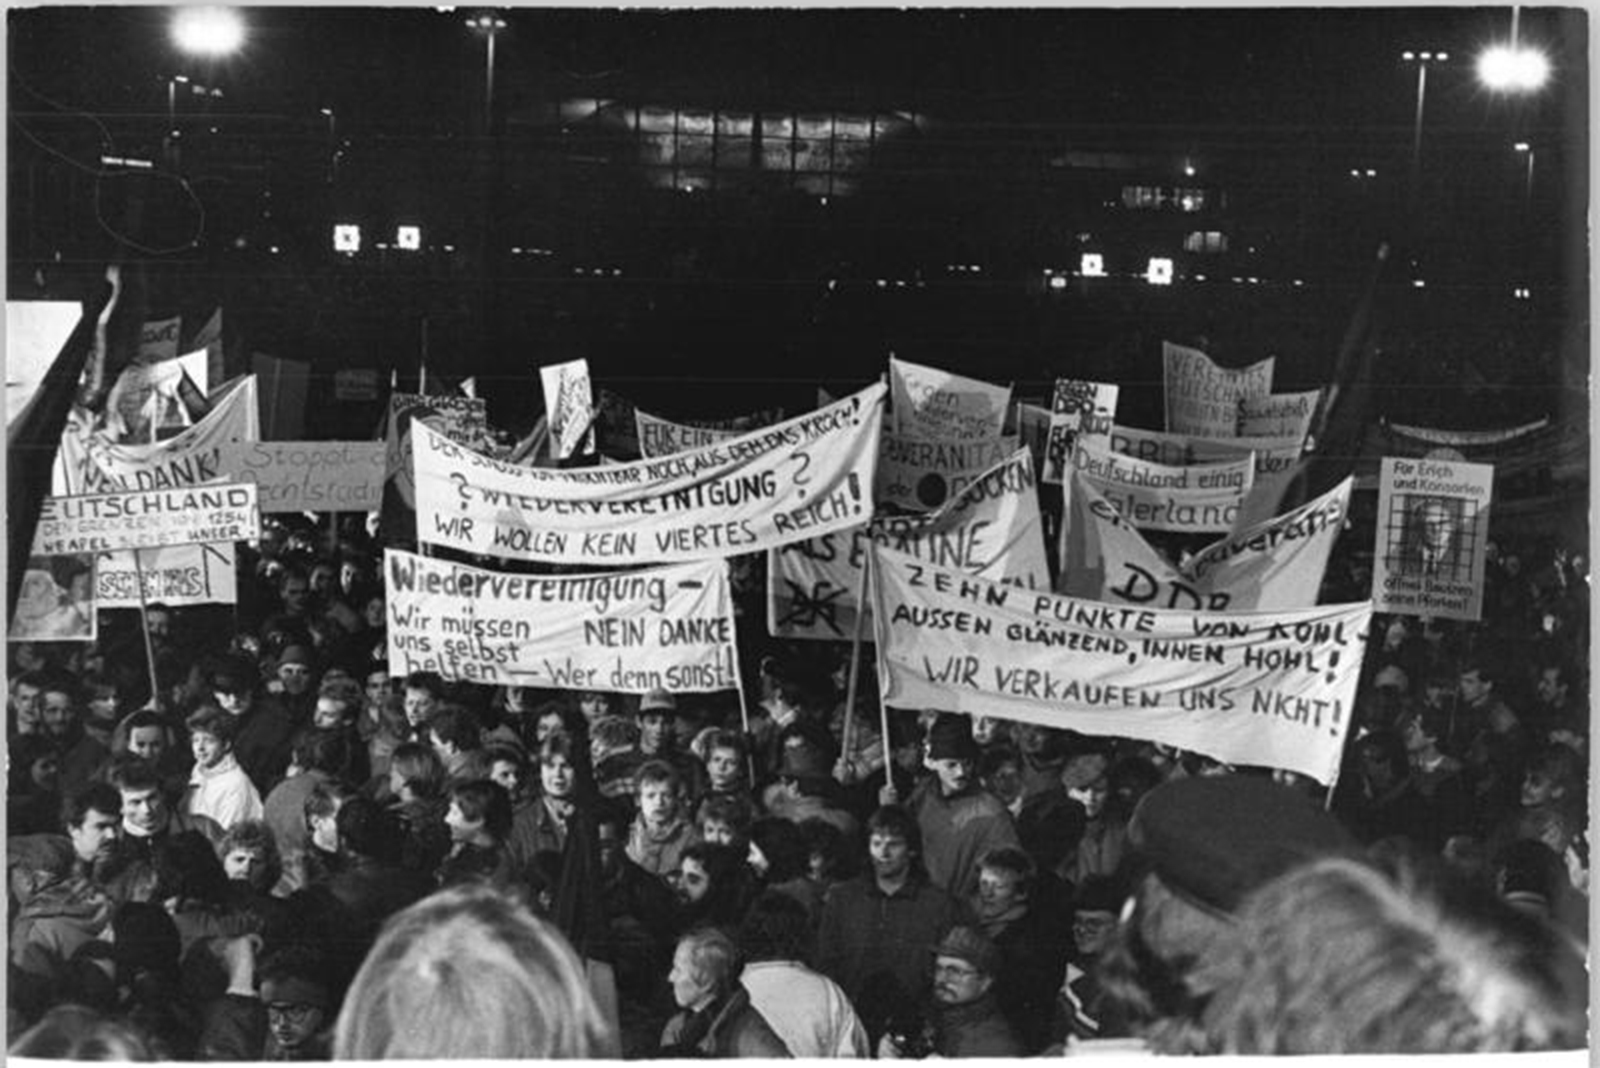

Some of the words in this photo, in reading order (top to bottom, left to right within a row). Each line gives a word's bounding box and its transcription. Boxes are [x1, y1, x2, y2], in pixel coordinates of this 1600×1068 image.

[1077, 447, 1188, 490] Deutschland
[1198, 468, 1244, 494] einig
[434, 511, 474, 542] WIR
[494, 525, 568, 554] WOLLEN
[581, 531, 638, 556] KEIN
[656, 518, 757, 553] VIERTES
[772, 471, 862, 534] REICH!
[391, 602, 431, 631] Wir
[442, 605, 532, 640] müssen
[905, 563, 1008, 607] ZEHN
[1034, 596, 1156, 633] PUNKTE
[1193, 616, 1250, 637] VON
[1267, 620, 1348, 646] KOHL
[394, 633, 431, 653] uns
[443, 626, 521, 664] selbst
[584, 616, 645, 647] NEIN
[659, 616, 731, 647] DANKE
[892, 603, 992, 635] AUSSEN
[1006, 620, 1137, 664] GLÄNZEND,
[1142, 637, 1225, 665] INNEN
[1244, 647, 1341, 684] HOHL!
[404, 650, 498, 683] helfen
[543, 657, 598, 687] Wer
[610, 655, 662, 689] denn
[666, 644, 739, 690] sonst!
[923, 655, 980, 690] WIR
[995, 665, 1161, 709] VERKAUFEN
[1179, 687, 1235, 711] UNS
[1252, 688, 1342, 737] NICHT!
